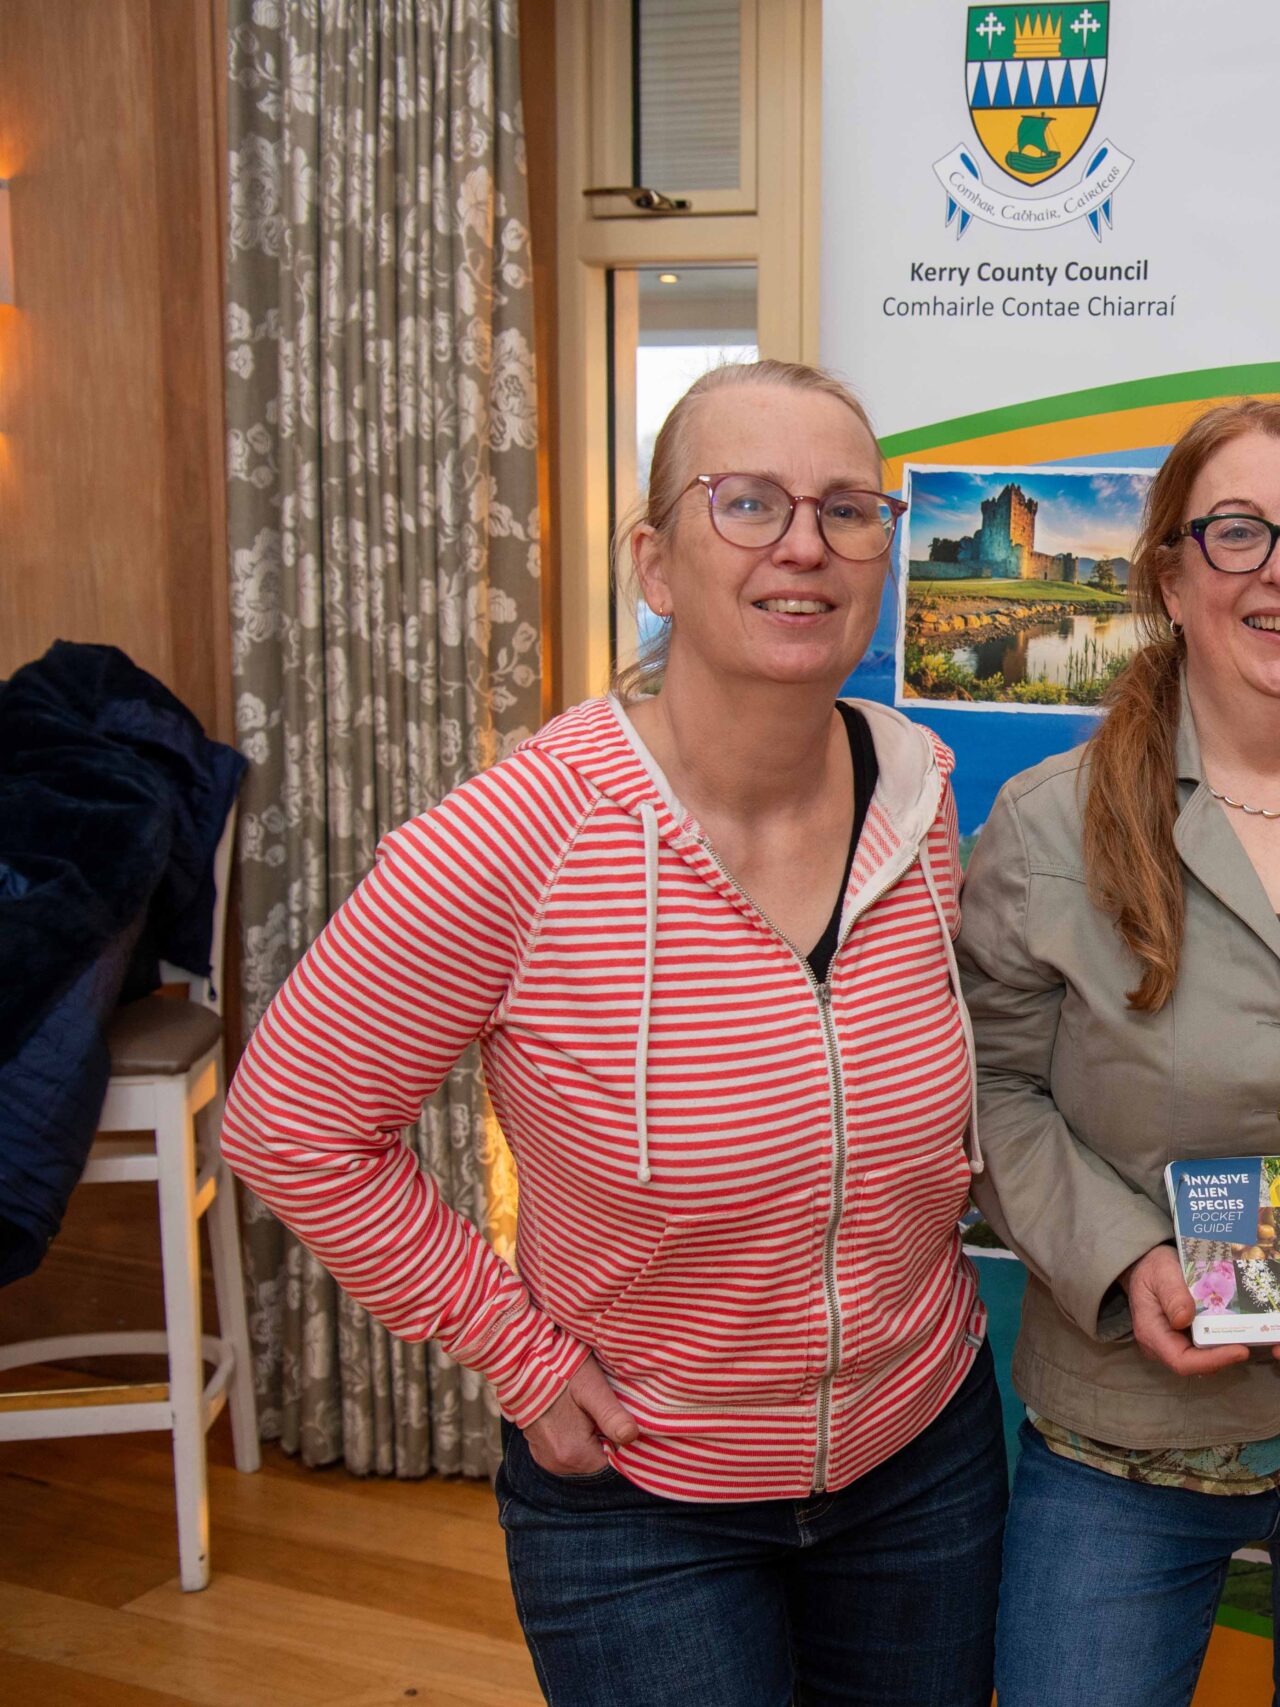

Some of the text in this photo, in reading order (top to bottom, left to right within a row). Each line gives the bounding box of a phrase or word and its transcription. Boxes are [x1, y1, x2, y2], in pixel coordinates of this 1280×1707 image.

[910, 259, 1149, 286] Kerry County Council
[882, 295, 1177, 317] Comhairle Contae Chiarraí
[1185, 1174, 1249, 1186] INVASIVE
[1188, 1187, 1228, 1198] ALIEN
[1190, 1199, 1244, 1211] SPECIES
[1191, 1211, 1244, 1222] POCKET
[1193, 1222, 1233, 1234] GUIDE
